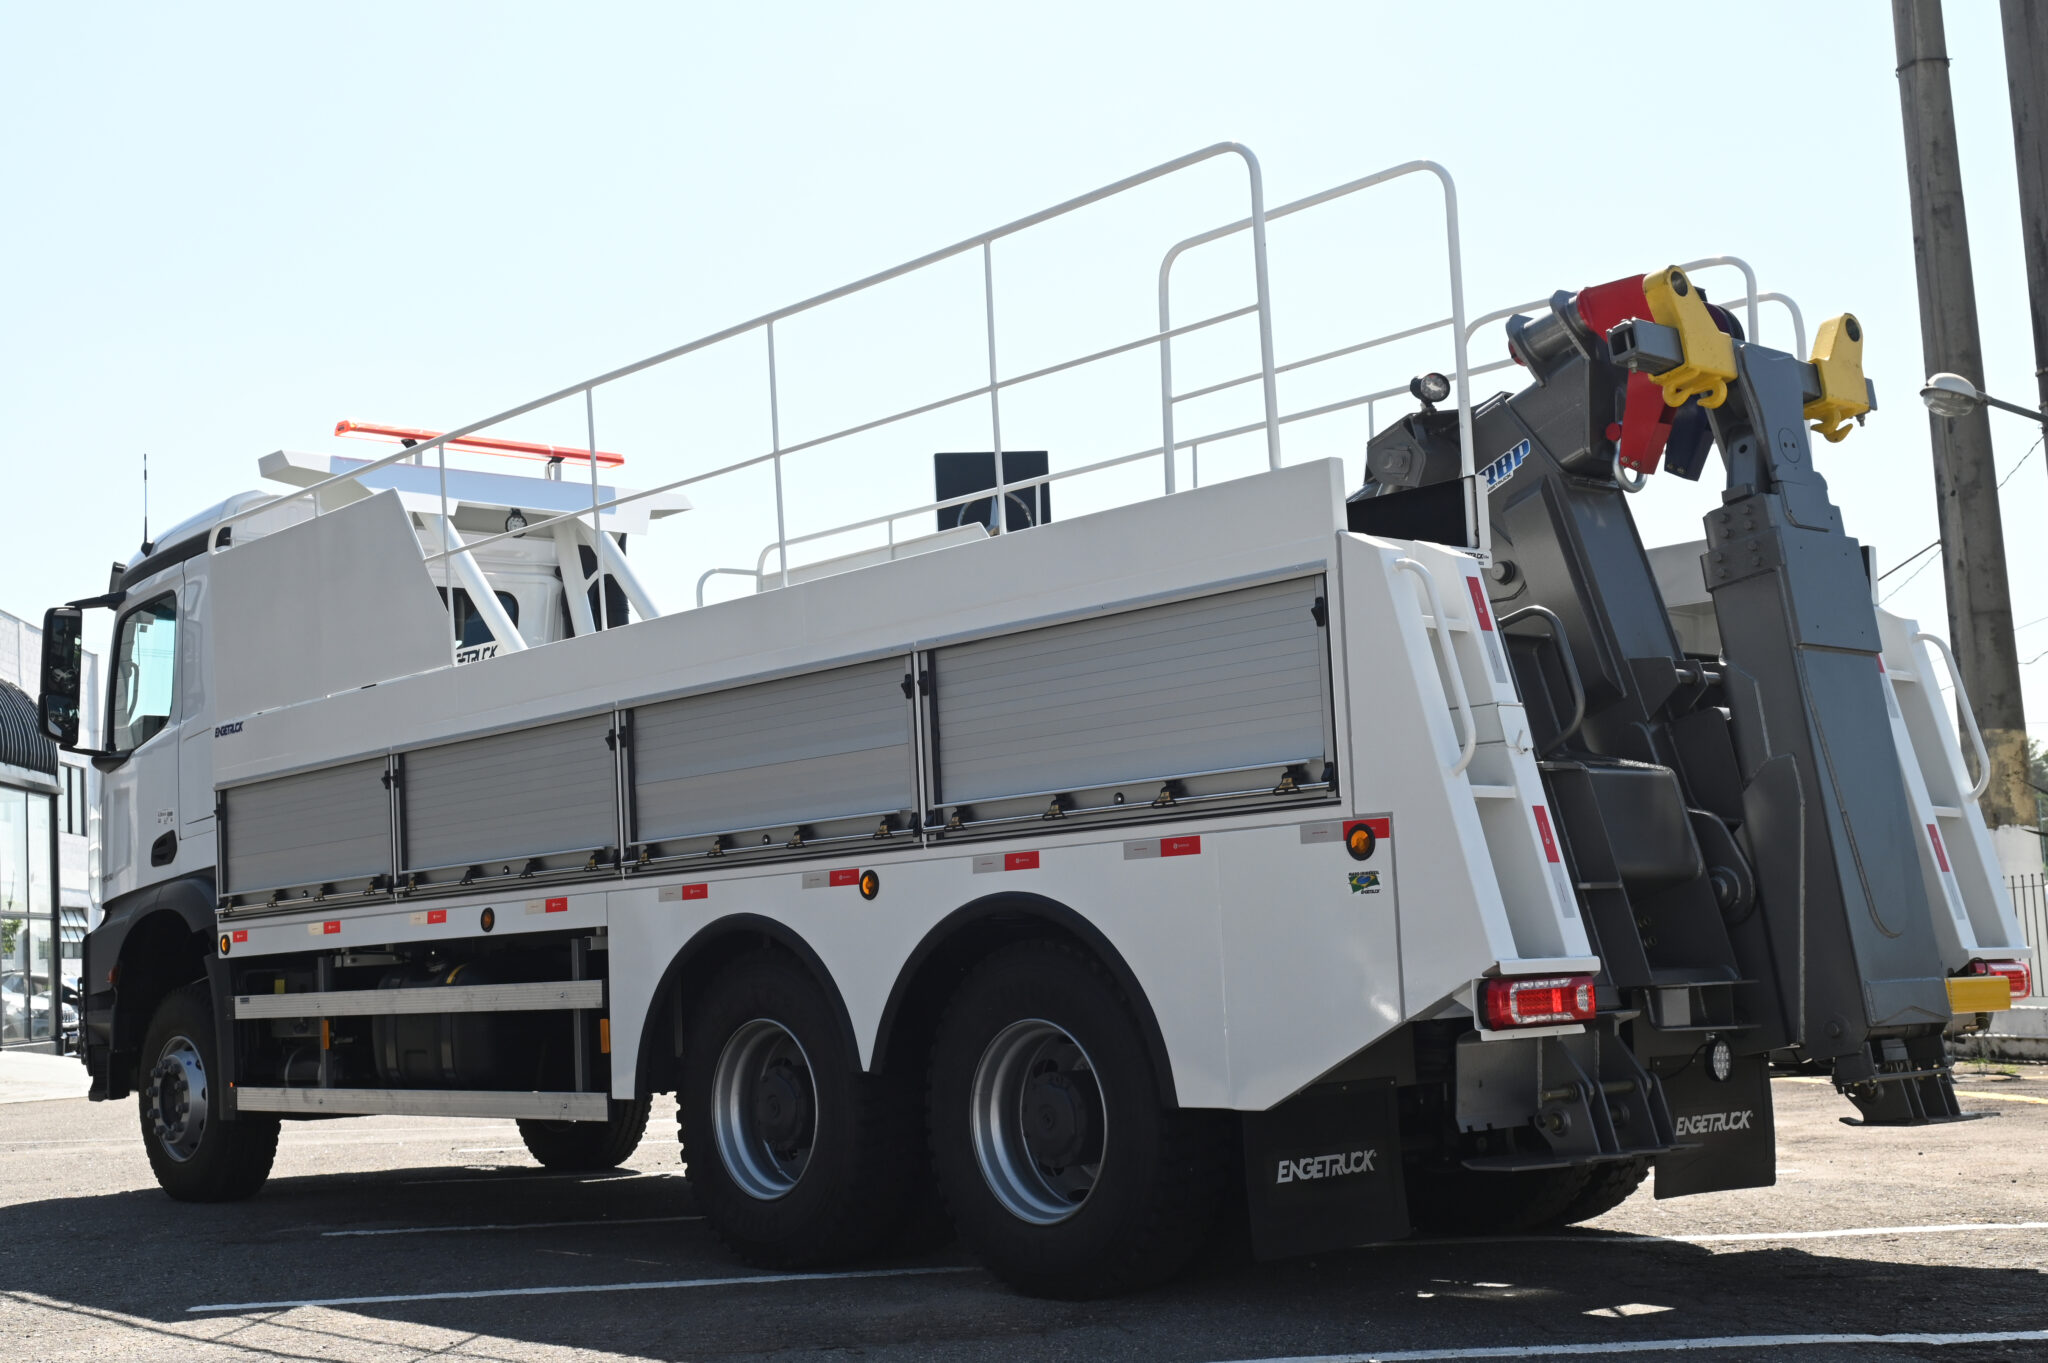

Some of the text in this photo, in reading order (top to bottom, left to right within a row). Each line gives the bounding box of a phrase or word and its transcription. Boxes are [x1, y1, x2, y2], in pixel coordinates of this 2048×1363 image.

[214, 720, 244, 738] ENGETRUCK
[1676, 1110, 1751, 1136] ENGETRUCK
[1276, 1149, 1375, 1184] ENGETRUCK
